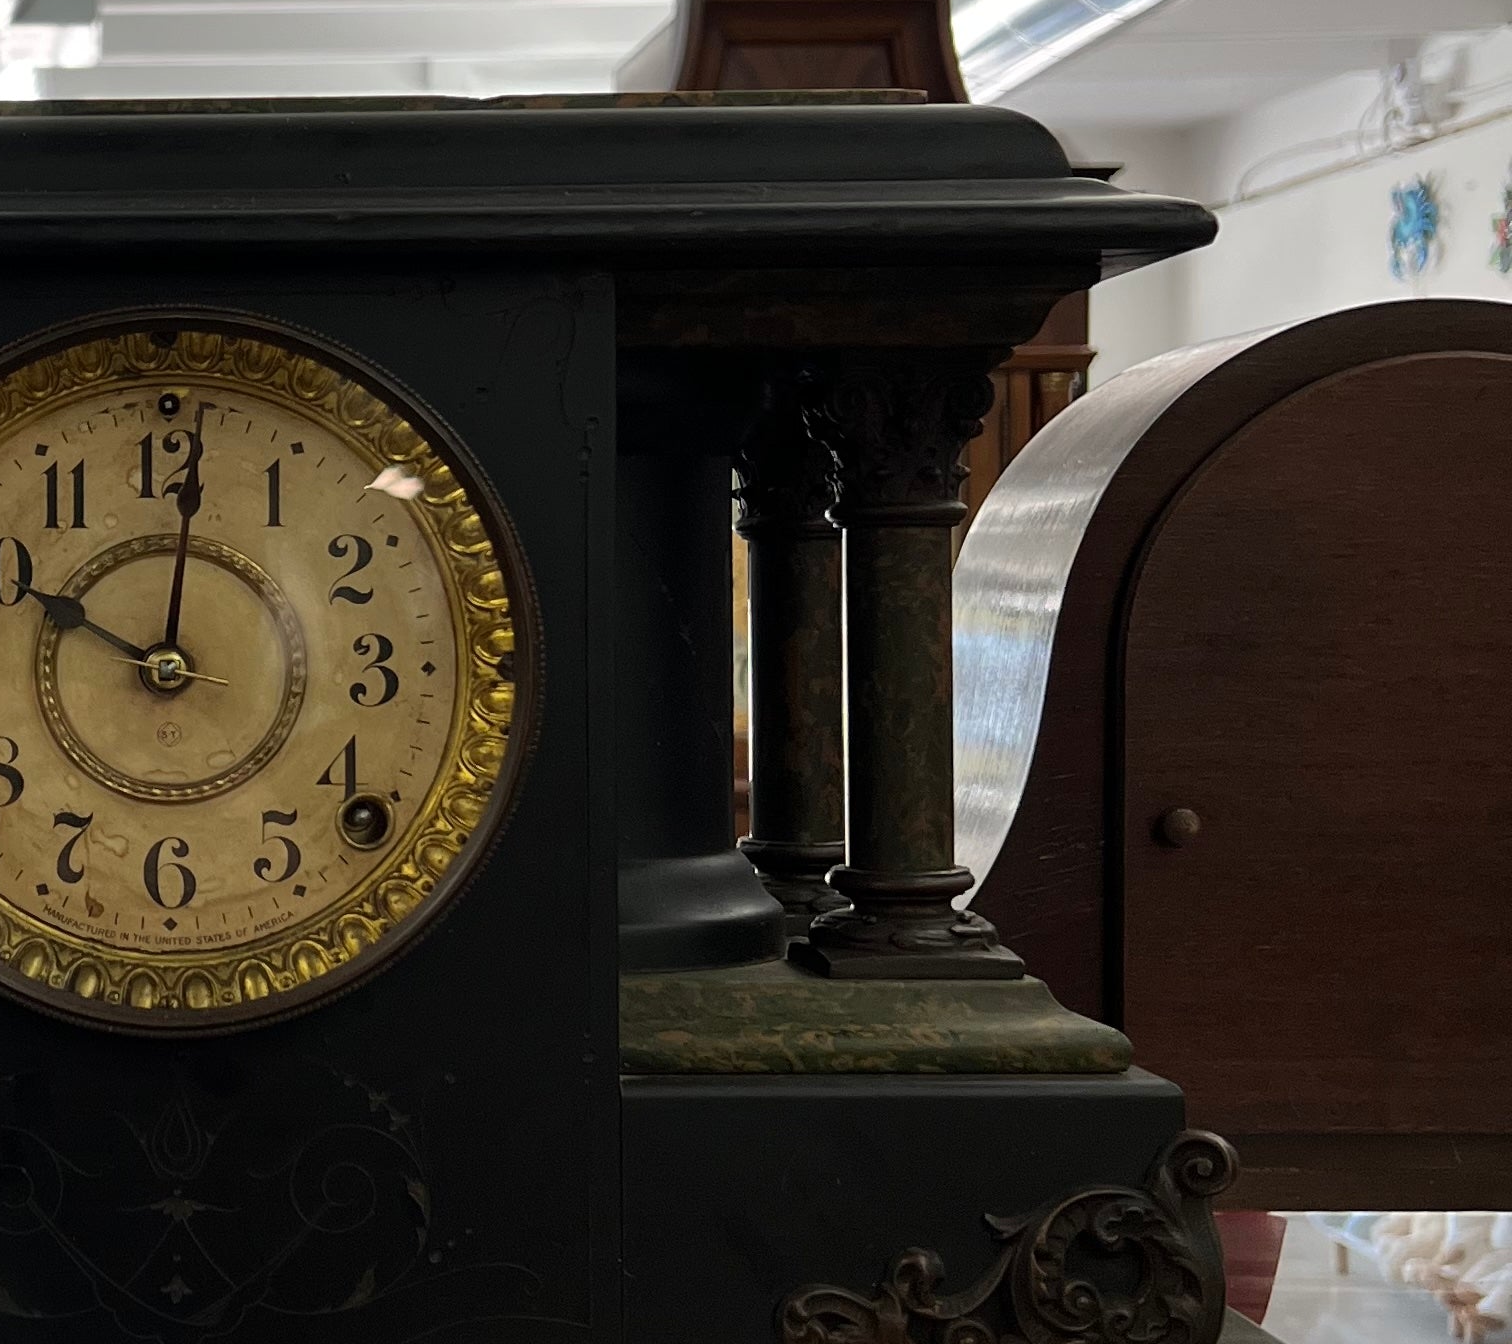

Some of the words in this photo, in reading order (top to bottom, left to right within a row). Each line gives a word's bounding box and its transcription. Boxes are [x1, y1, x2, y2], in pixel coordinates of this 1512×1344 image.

[42, 459, 88, 528] 11
[135, 429, 204, 499] 12
[262, 459, 284, 527] 1
[328, 535, 374, 605] 2
[349, 633, 400, 707] 3
[316, 734, 368, 804] 4
[53, 812, 94, 884] 7
[143, 837, 197, 909] 6
[254, 809, 301, 883] 5
[42, 903, 117, 939] MANUFACTURED
[119, 932, 130, 942] IN
[133, 934, 152, 945] THE
[155, 936, 192, 946] UNITED
[195, 931, 233, 945] STATES
[235, 926, 248, 939] OF
[253, 910, 295, 935] AMERICA
